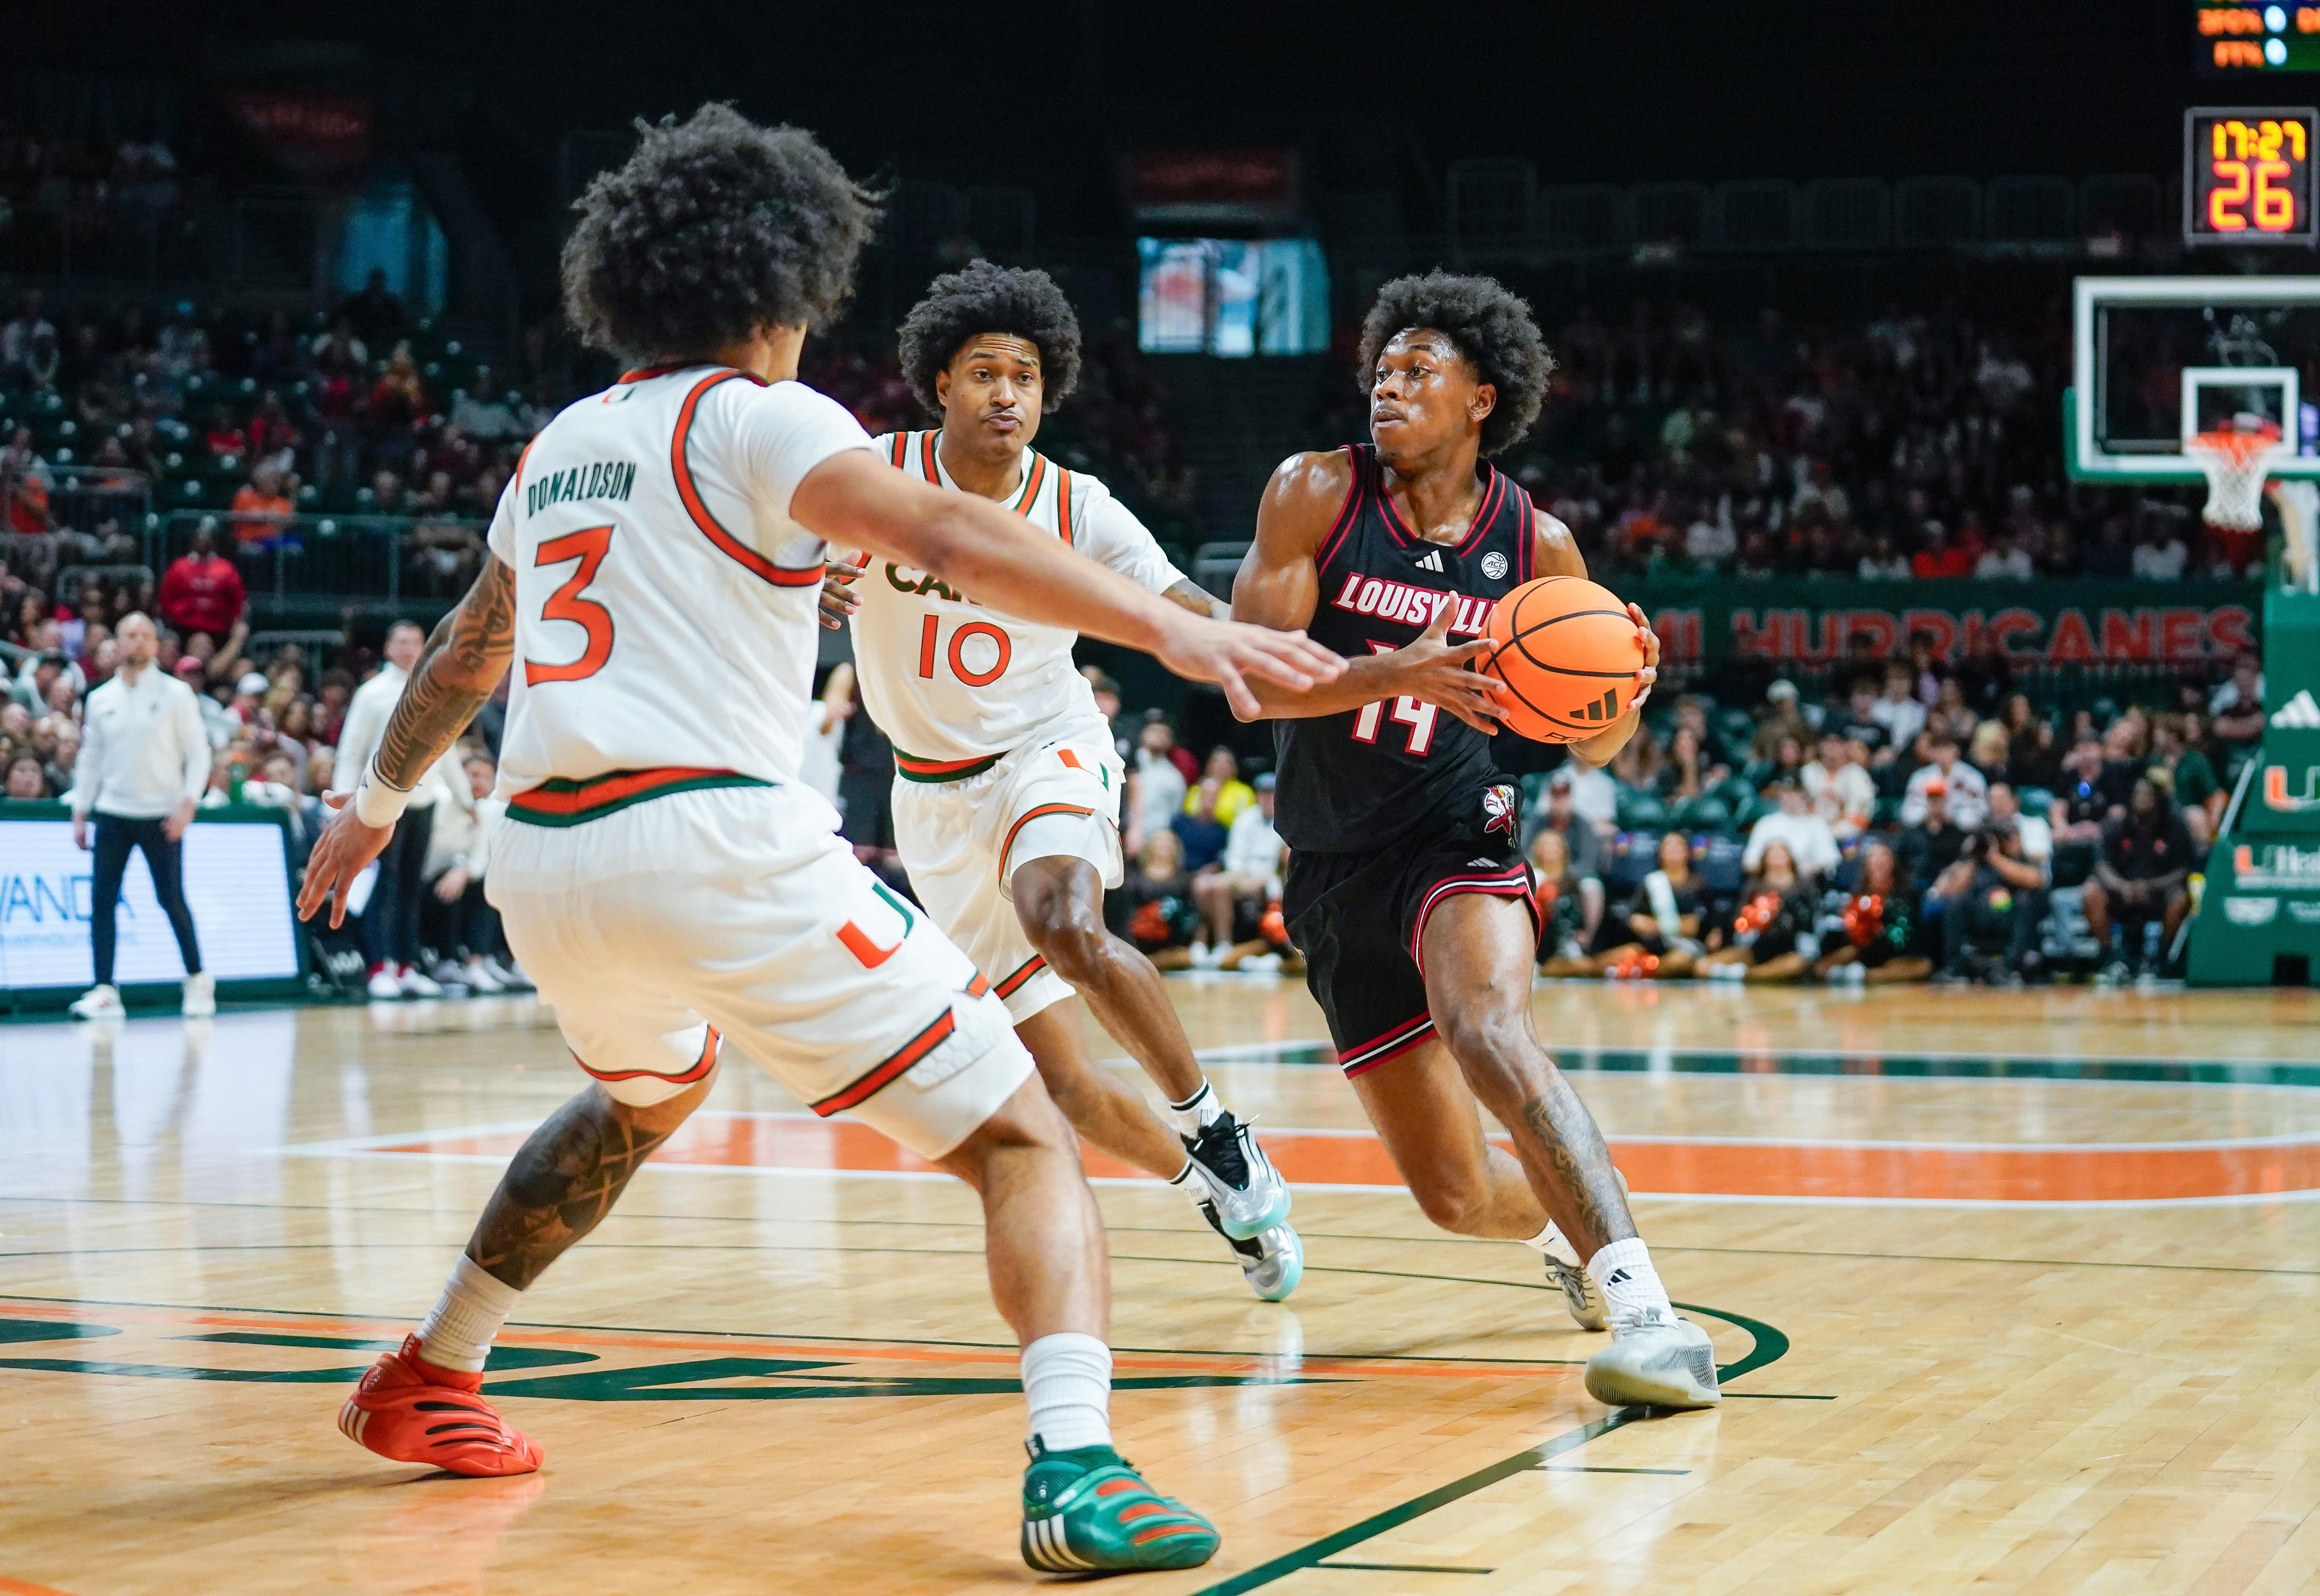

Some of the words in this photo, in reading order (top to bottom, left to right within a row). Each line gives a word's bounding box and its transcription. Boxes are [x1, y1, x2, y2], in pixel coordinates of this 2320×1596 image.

[2212, 120, 2306, 161] 17:27
[2209, 160, 2294, 232] 26
[528, 460, 637, 519] DONALDSON
[525, 524, 616, 687] 3
[1331, 571, 1500, 638] LOUISVLL
[919, 613, 1011, 687] 10
[1351, 638, 1440, 757] 14
